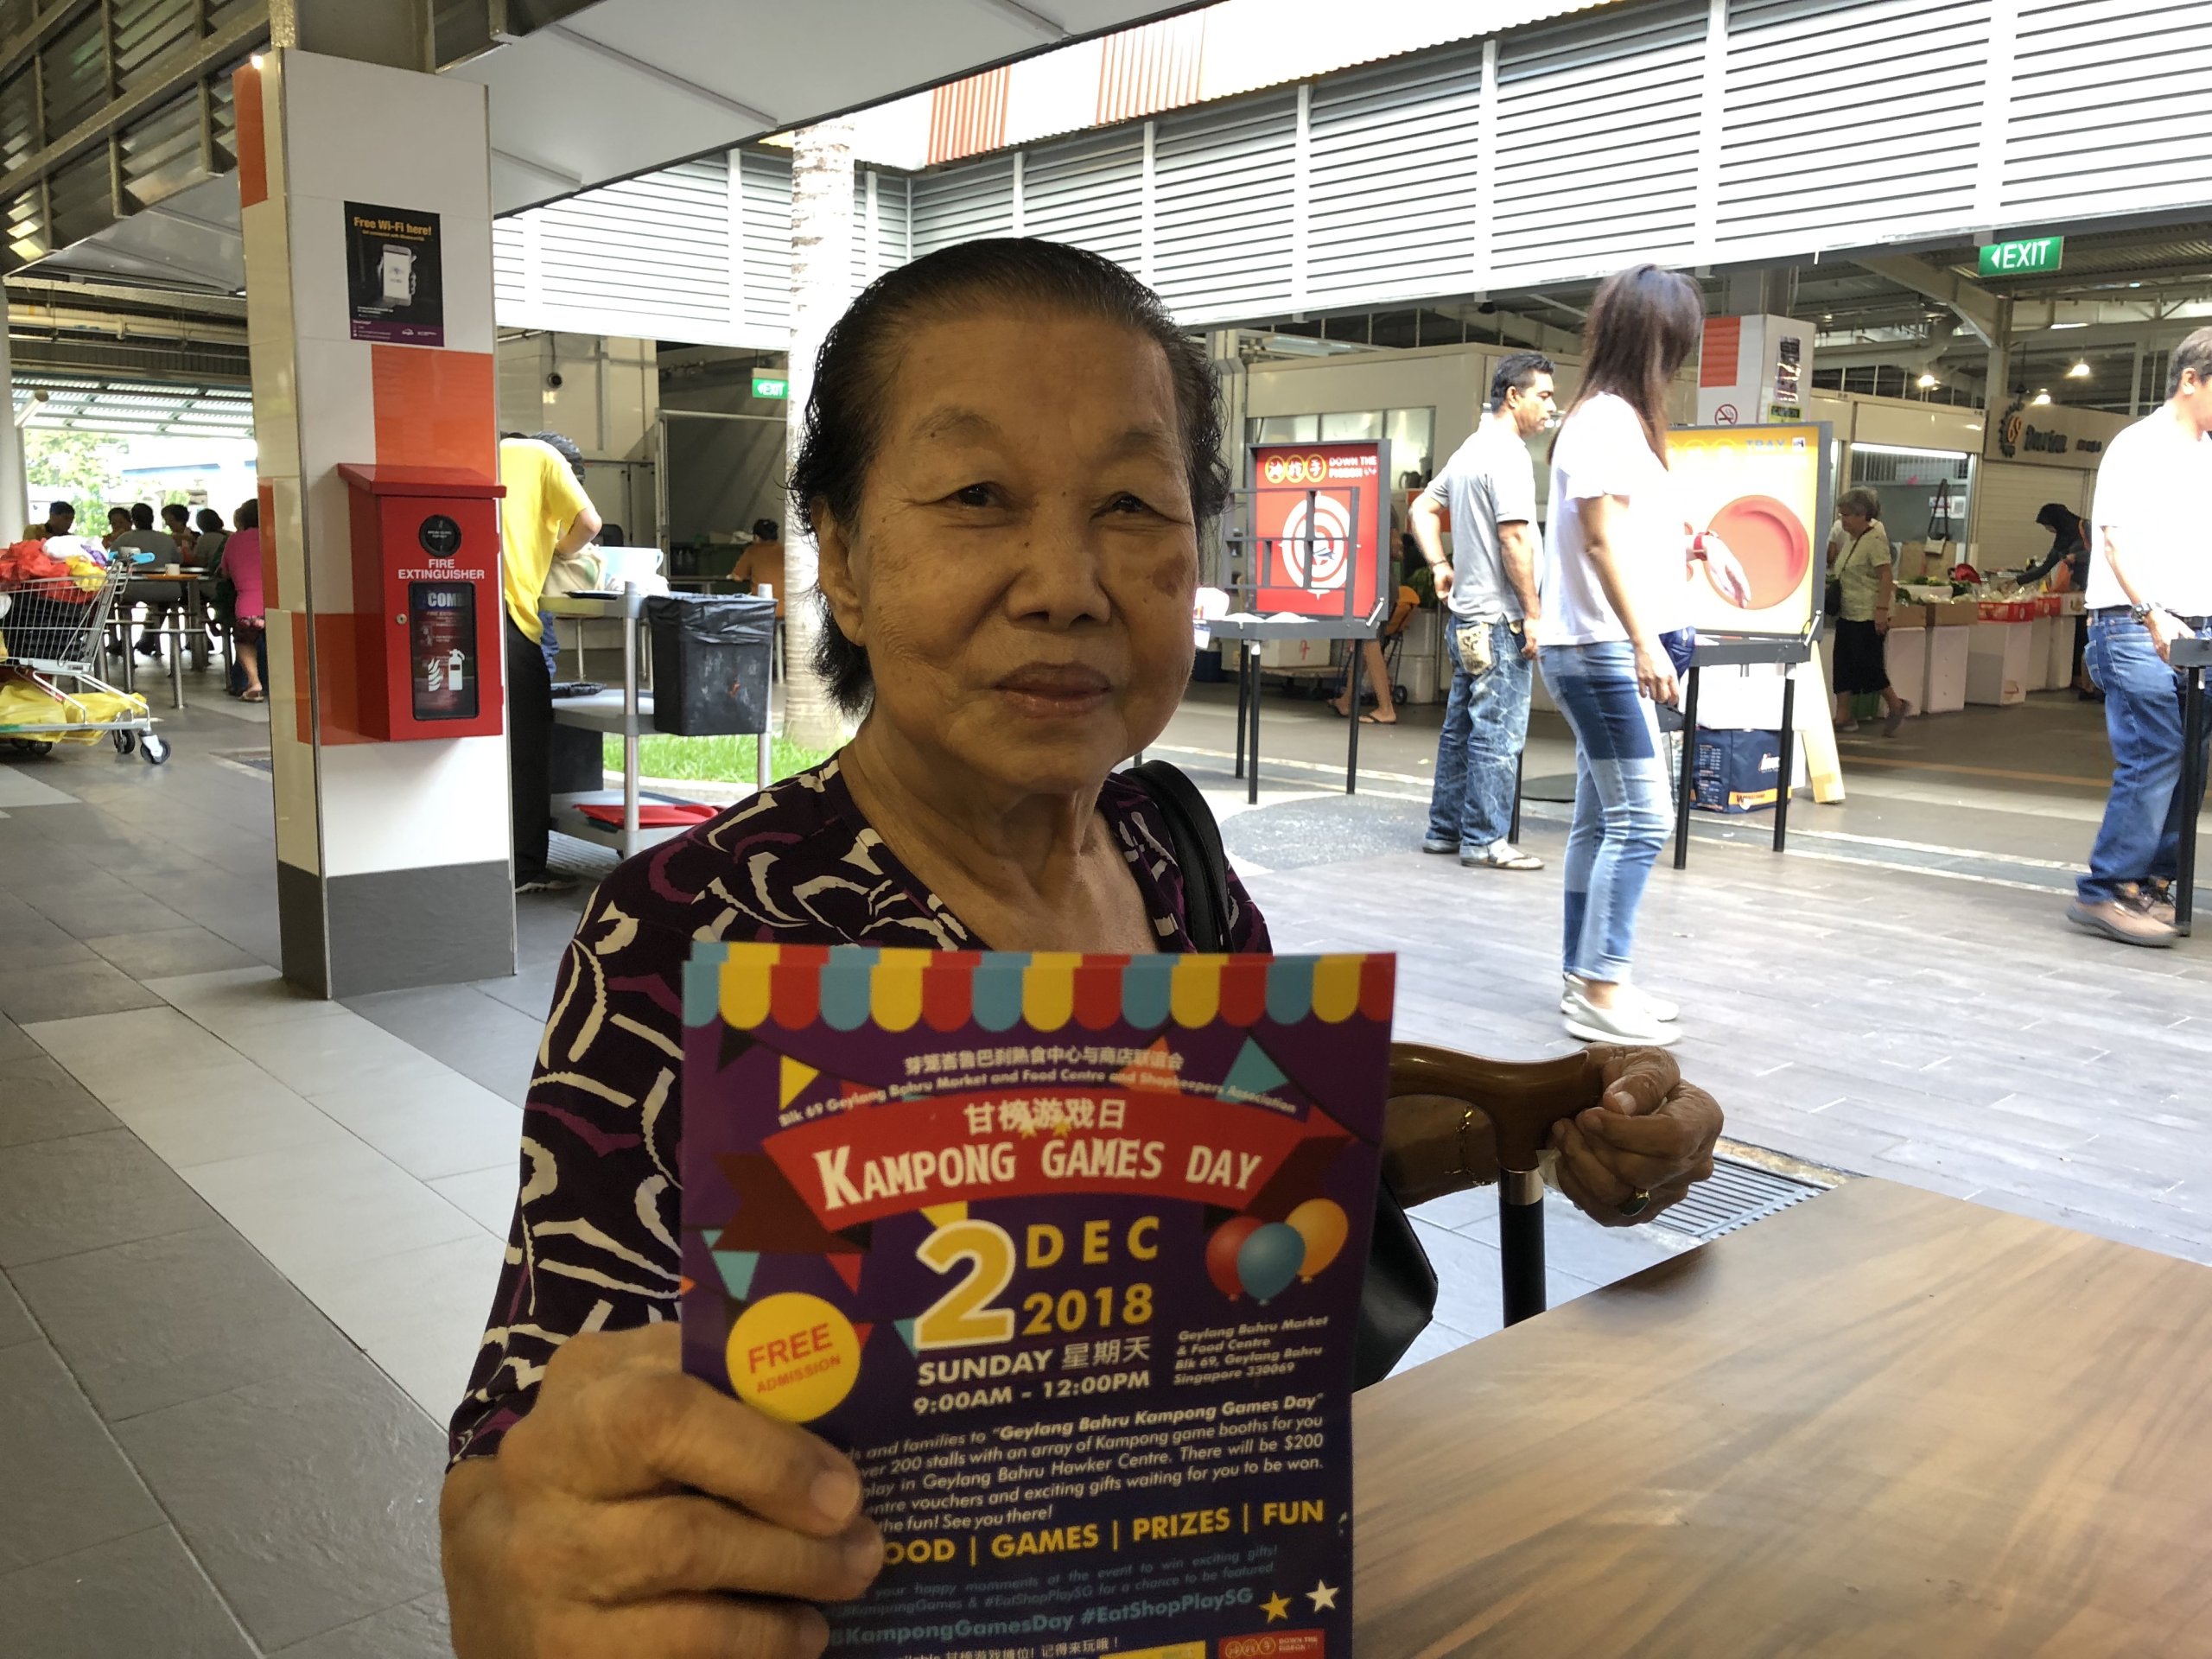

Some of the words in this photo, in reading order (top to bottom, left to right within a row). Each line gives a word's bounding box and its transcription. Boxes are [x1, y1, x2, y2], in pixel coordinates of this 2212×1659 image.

[353, 216, 376, 228] Free
[378, 219, 404, 232] Wi-Fi
[406, 223, 432, 235] here!
[2003, 240, 2051, 269] EXIT
[762, 382, 785, 397] EXIT
[1328, 458, 1358, 467] DOWN
[1359, 455, 1377, 466] THE
[397, 569, 485, 580] EXTINGUISHER
[429, 558, 455, 569] FIRE
[778, 1109, 804, 1128] Blk
[804, 1103, 824, 1118] 69
[936, 1074, 988, 1090] Market
[990, 1070, 1020, 1084] and
[1022, 1068, 1057, 1082] Food
[1059, 1068, 1106, 1083] Centre
[1227, 1084, 1296, 1115] Association
[1040, 1137, 1166, 1180] GAMES
[1185, 1144, 1262, 1191] DAY
[912, 1219, 1017, 1351] 2
[1026, 1214, 1160, 1269] DEC
[1021, 1282, 1154, 1336] 2018
[1178, 1326, 1235, 1343] Geylang
[1237, 1321, 1278, 1335] Bahru
[1281, 1315, 1329, 1331] Market
[1191, 1340, 1225, 1355] Food
[1228, 1338, 1271, 1351] Centre
[747, 1322, 834, 1375] FREE
[917, 1348, 1053, 1387] SUNDAY
[1060, 1335, 1152, 1371] 星期天
[1174, 1359, 1196, 1371] Blk
[1199, 1356, 1220, 1368] 69,
[1224, 1351, 1281, 1366] Geylang
[1283, 1345, 1323, 1359] Bahru
[757, 1354, 842, 1394] ADMISSION
[1173, 1370, 1243, 1386] Singapore
[912, 1385, 1014, 1416] 9:00AM
[1042, 1370, 1150, 1400] 12:00PM
[866, 1441, 899, 1460] and
[902, 1432, 966, 1454] families
[969, 1429, 987, 1444] to
[1079, 1414, 1130, 1433] Bahru
[1135, 1406, 1217, 1426] Kampong
[1222, 1399, 1280, 1417] Games
[890, 1455, 923, 1473] 200
[925, 1449, 967, 1466] stalls
[969, 1446, 1003, 1464] with
[1007, 1446, 1028, 1460] an
[1031, 1441, 1073, 1458] array
[1075, 1435, 1094, 1453] of
[1095, 1431, 1168, 1451] Kampong
[1172, 1424, 1216, 1447] game
[1218, 1421, 1268, 1438] booths
[1271, 1415, 1294, 1430] for
[1295, 1415, 1324, 1433] you
[900, 1477, 916, 1491] in
[922, 1471, 992, 1491] Geylang
[998, 1464, 1045, 1484] Bahru
[1051, 1456, 1113, 1476] Hawker
[1179, 1445, 1223, 1463] There
[1228, 1439, 1254, 1456] will
[1259, 1438, 1278, 1452] be
[1284, 1433, 1324, 1452] $200
[912, 1493, 983, 1510] vouchers
[988, 1485, 1020, 1505] and
[1024, 1480, 1084, 1499] exciting
[1089, 1474, 1122, 1496] gifts
[1126, 1470, 1182, 1488] waiting
[1186, 1465, 1209, 1482] for
[1211, 1465, 1239, 1482] you
[1243, 1461, 1259, 1474] to
[1263, 1457, 1283, 1473] be
[1287, 1458, 1325, 1471] won.
[907, 1514, 939, 1530] fun!
[942, 1512, 971, 1528] See
[974, 1514, 1003, 1530] you
[1007, 1504, 1053, 1522] there!
[991, 1522, 1099, 1560] GAMES
[1132, 1507, 1231, 1542] PRIZES
[1262, 1499, 1325, 1526] FUN
[1097, 1565, 1133, 1579] event
[1161, 1559, 1184, 1569] win
[1192, 1552, 1240, 1568] exciting
[1202, 1569, 1218, 1582] be
[1081, 1587, 1254, 1624] #EatShopPlaySG
